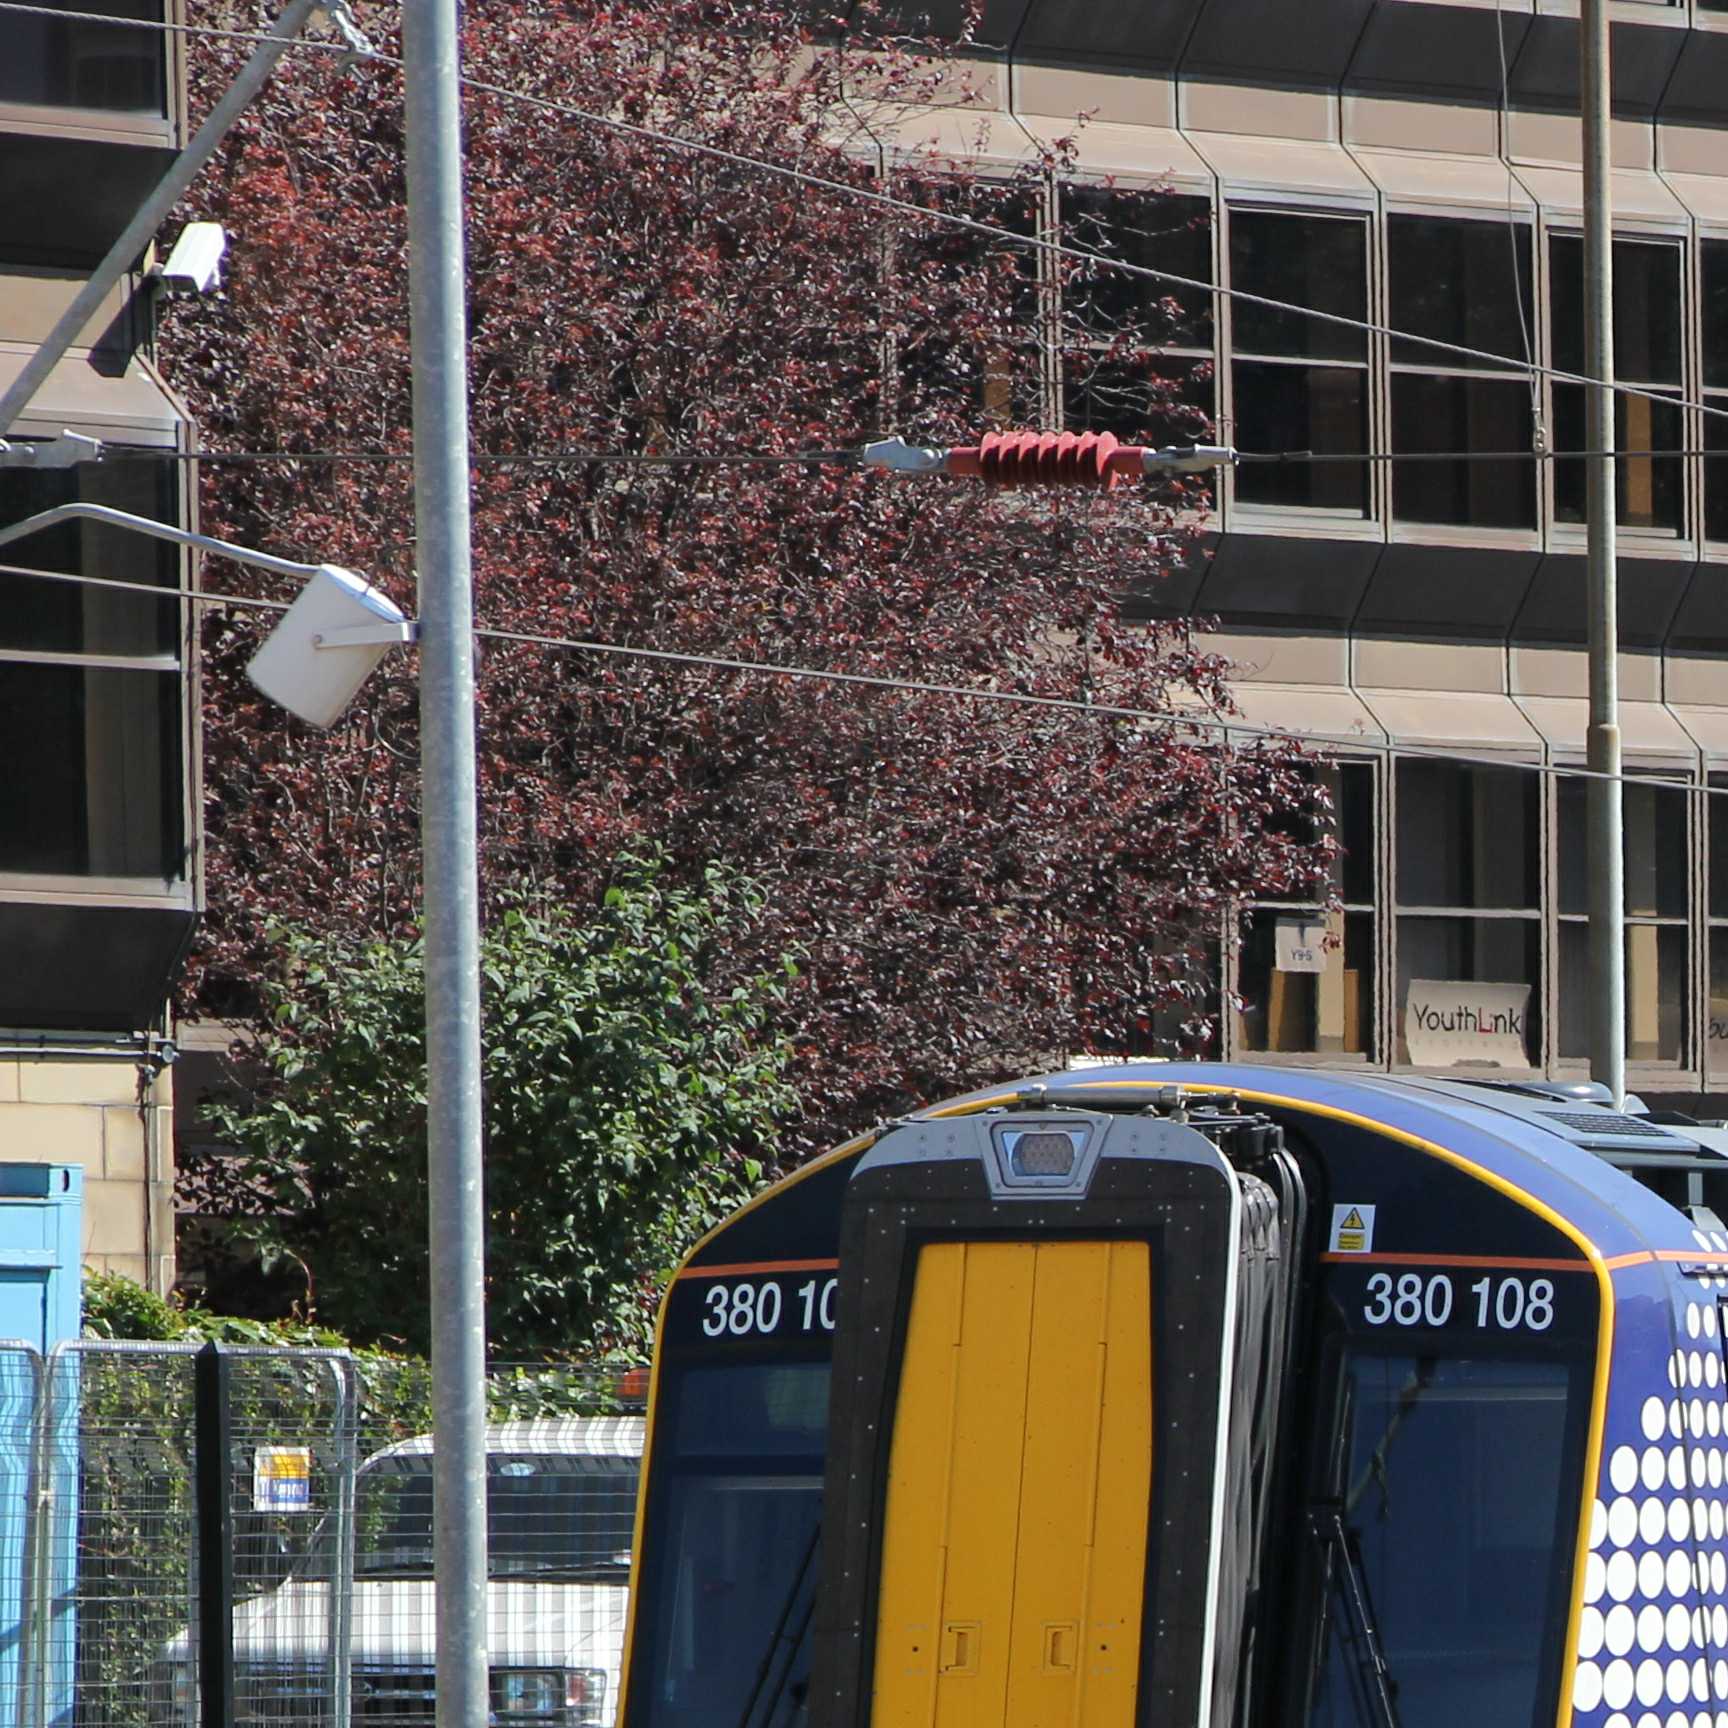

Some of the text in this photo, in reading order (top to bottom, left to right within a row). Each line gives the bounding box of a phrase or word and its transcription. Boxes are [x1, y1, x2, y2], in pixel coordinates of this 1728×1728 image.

[704, 1278, 838, 1338] 380 10
[1363, 1272, 1555, 1331] 380 108
